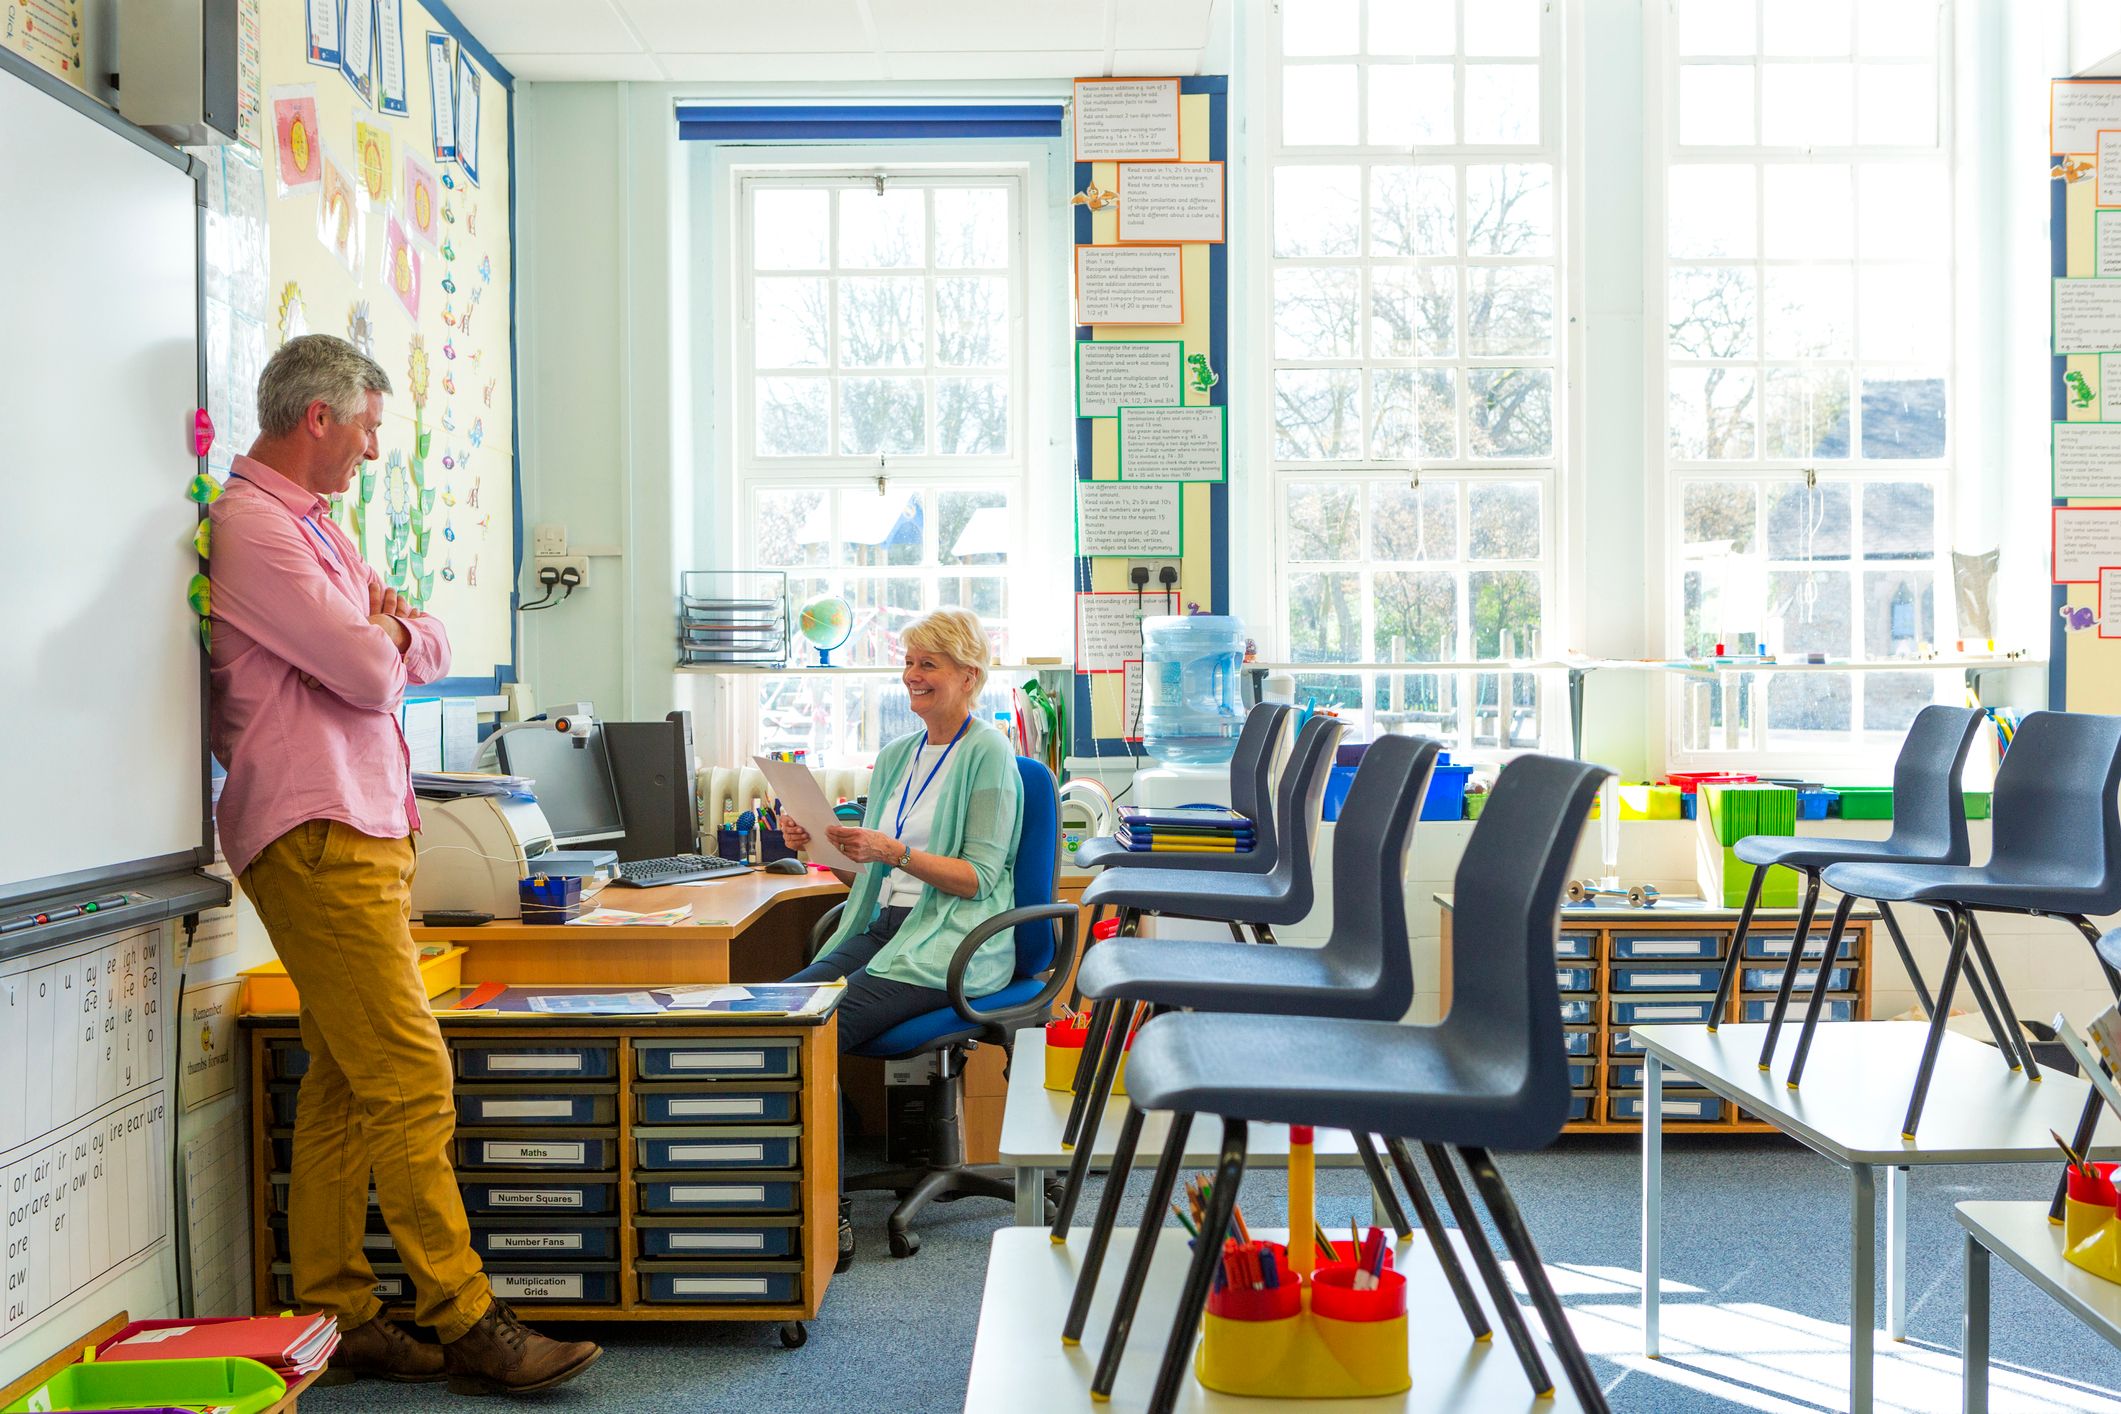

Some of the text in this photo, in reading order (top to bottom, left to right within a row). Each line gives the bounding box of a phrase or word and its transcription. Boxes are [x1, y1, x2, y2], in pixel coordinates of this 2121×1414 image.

[11, 944, 156, 1006] i o u ay ee igh ow
[86, 1000, 156, 1042] ai ea ie oa
[192, 1002, 222, 1021] Remember
[106, 1030, 153, 1060] e i o
[188, 1048, 228, 1075] thumbs forward
[126, 1066, 131, 1086] y
[14, 1104, 164, 1192] or air ir ou oy ire ear ure
[520, 1148, 548, 1158] Maths
[9, 1161, 103, 1227] oor are ur ow oi
[498, 1194, 572, 1204] Number Squares
[9, 1212, 65, 1258] ore er
[505, 1238, 565, 1246] Number Fans
[9, 1267, 27, 1290] aw
[506, 1277, 566, 1287] Multiplication
[524, 1287, 549, 1297] Grids
[9, 1301, 24, 1322] au
